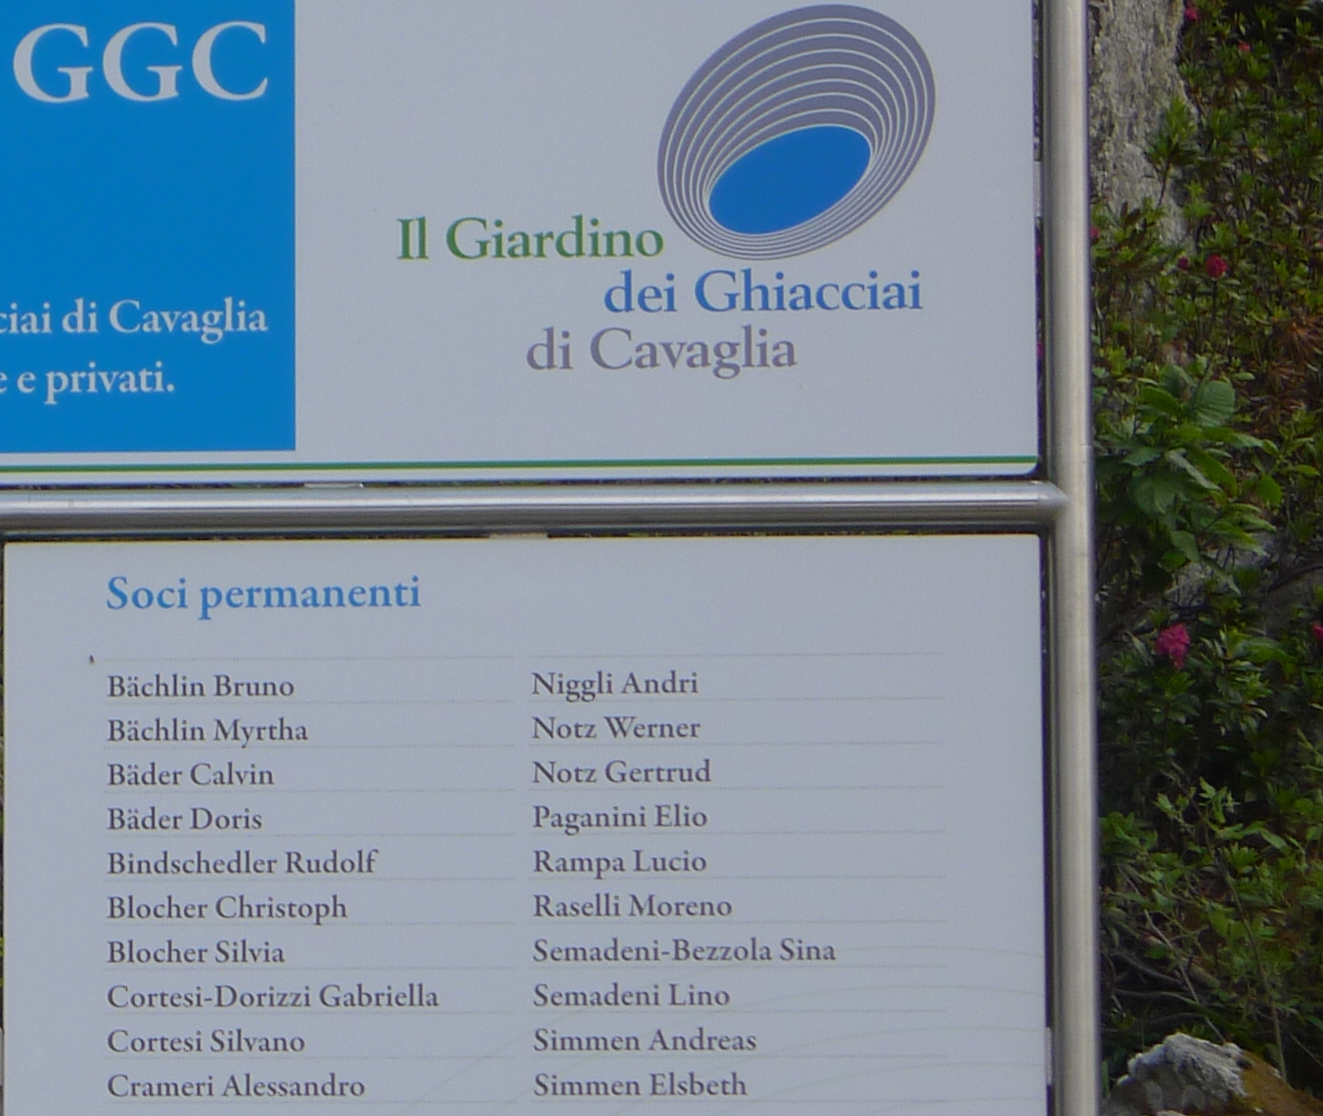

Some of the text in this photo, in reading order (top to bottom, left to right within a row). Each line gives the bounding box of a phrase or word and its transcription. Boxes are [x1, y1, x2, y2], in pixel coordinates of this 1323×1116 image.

[13, 21, 269, 103] GGC
[398, 215, 664, 260] Il Giardino
[604, 268, 921, 312] dei Ghiacciai
[62, 298, 98, 333] di
[109, 297, 268, 344] Cavaglia
[527, 324, 797, 379] di Cavaglia
[17, 372, 35, 393] e
[45, 361, 174, 405] privati.
[107, 576, 420, 620] Soci permanenti
[532, 670, 698, 703] Niggli Andri
[108, 761, 274, 786] Bäder Calvin
[533, 758, 711, 783] Notz Gertrud
[108, 849, 379, 874] Bindschedler Rudolf
[108, 894, 347, 926] Blocher Christoph
[533, 937, 836, 962] Semadeni-Bezzola Sina
[108, 983, 439, 1008] Cortesi-Dorizzi Gabriella
